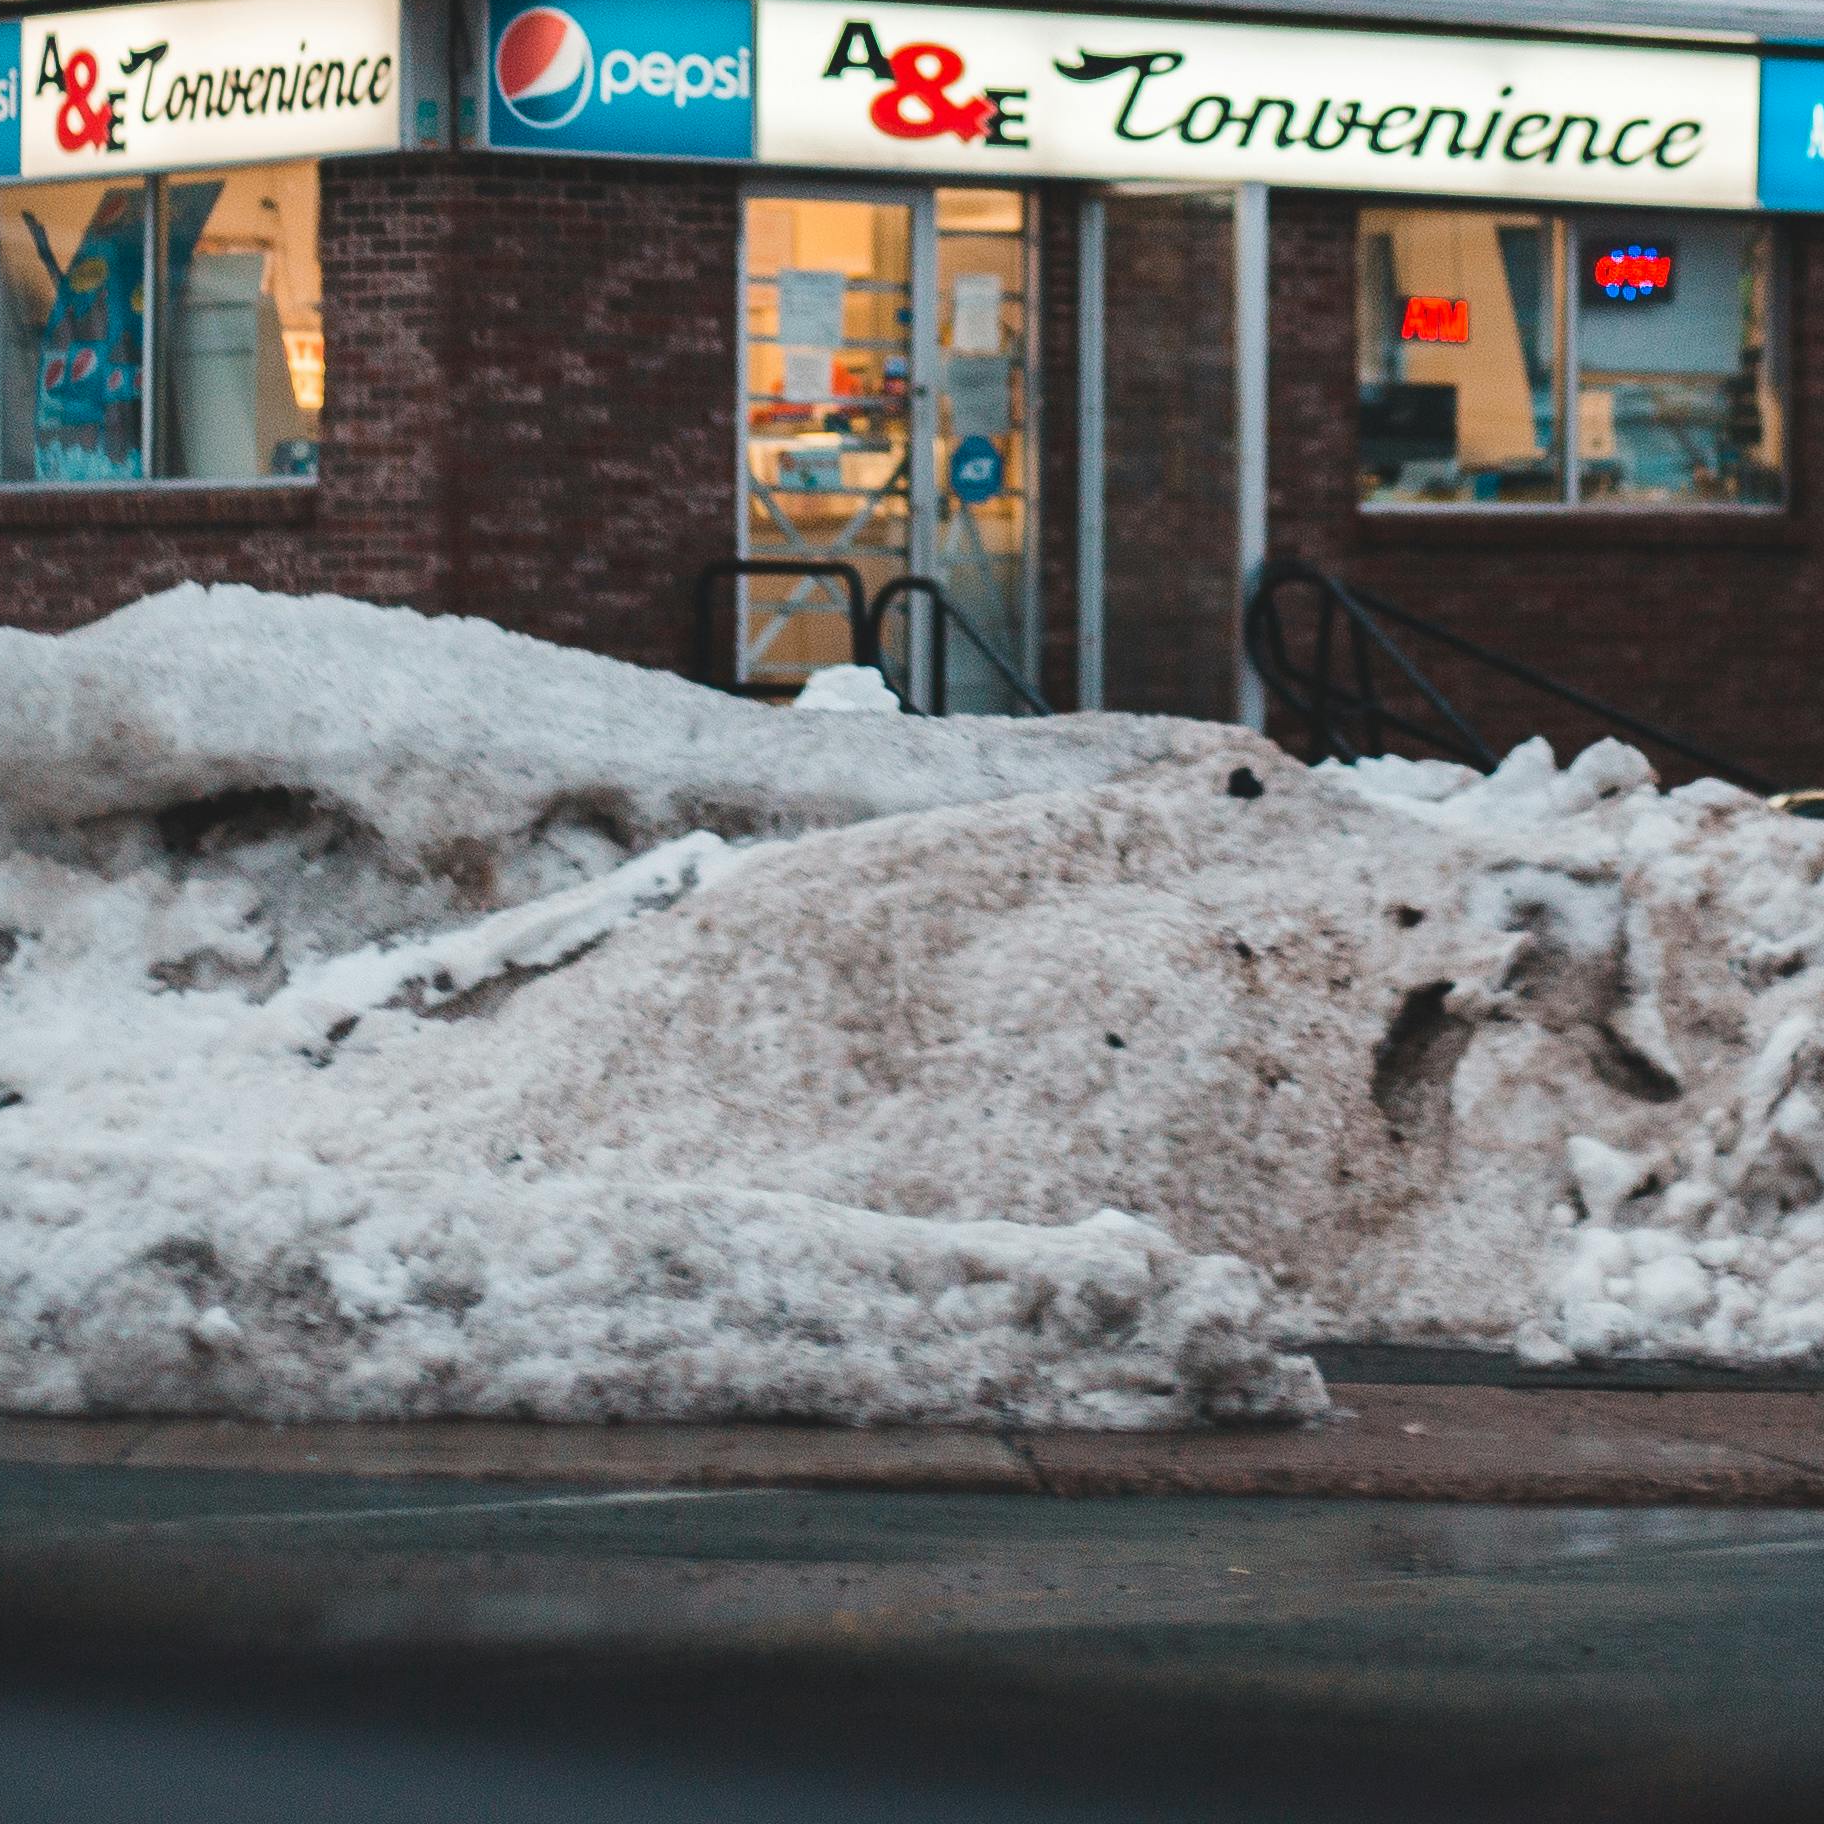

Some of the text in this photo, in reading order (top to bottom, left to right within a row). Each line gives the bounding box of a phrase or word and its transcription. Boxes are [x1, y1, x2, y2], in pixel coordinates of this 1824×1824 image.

[121, 41, 392, 124] Convenience
[599, 46, 751, 107] pepsi
[1053, 48, 1702, 168] Convenience
[1401, 296, 1469, 343] ATM
